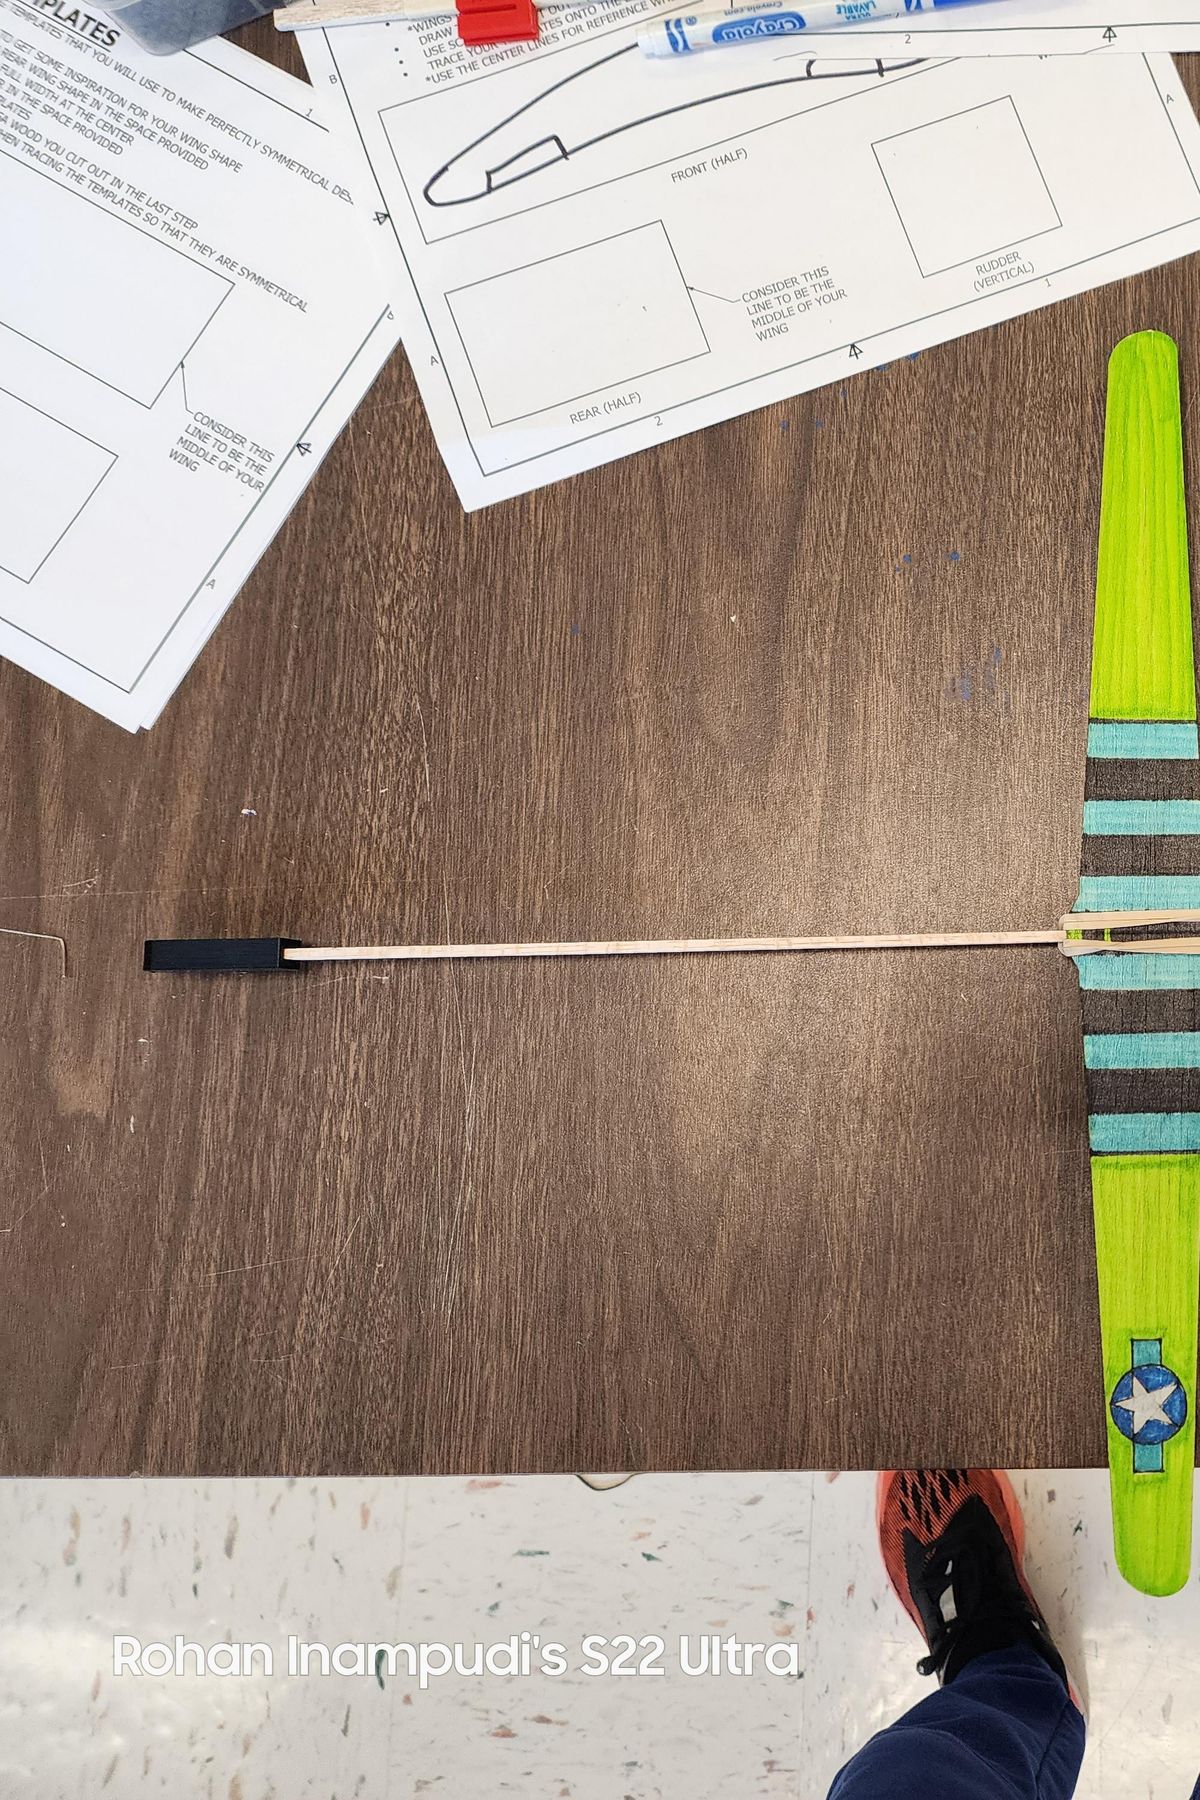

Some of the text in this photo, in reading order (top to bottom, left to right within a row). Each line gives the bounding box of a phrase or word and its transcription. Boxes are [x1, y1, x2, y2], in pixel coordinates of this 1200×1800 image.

[418, 27, 453, 46] DRAW
[427, 51, 465, 70] TRACE
[466, 42, 499, 58] YOUR
[565, 5, 597, 23] ONTO
[456, 61, 480, 76] THE
[482, 45, 526, 67] CENTER
[527, 33, 560, 51] LINES
[561, 24, 585, 39] FOR
[586, 1, 649, 30] REFERENCE
[721, 16, 800, 41] Crayola
[905, 34, 911, 44] 2
[423, 43, 447, 58] USE
[328, 74, 338, 84] B
[14, 39, 36, 54] GET
[34, 50, 65, 73] SOME
[63, 66, 127, 108] INSPIRATION
[127, 103, 149, 120] FOR
[150, 115, 178, 138] YOUR
[180, 131, 209, 154] WING
[208, 148, 243, 173] SHAPE
[25, 78, 59, 102] WIDTH
[59, 99, 76, 111] AT
[74, 105, 96, 123] THE
[95, 118, 134, 146] CENTER
[65, 33, 92, 53] THAT
[92, 49, 113, 67] YOU
[114, 61, 137, 81] WILL
[138, 76, 161, 93] USE
[161, 88, 177, 102] TO
[176, 97, 206, 119] MAKE
[205, 113, 261, 149] PERFECTLY
[260, 144, 329, 190] SYMMETRICAL
[1166, 94, 1174, 104] A
[5, 83, 19, 96] IN
[20, 91, 42, 109] THE
[40, 104, 73, 128] SPACE
[72, 122, 123, 155] PROVIDED
[28, 63, 58, 85] WING
[57, 80, 90, 103] SHAPE
[89, 98, 103, 111] IN
[104, 105, 125, 123] THE
[124, 117, 158, 142] SPACE
[157, 136, 209, 171] PROVIDED
[10, 119, 199, 230] WOOD YOU CUT OUT IN THE LAST STEP
[671, 148, 748, 183] FRONT (HALF)
[20, 141, 65, 172] TRACING
[66, 167, 87, 185] THE
[87, 179, 144, 217] TEMPLATES
[142, 212, 160, 226] SO
[160, 220, 189, 242] THAT
[188, 236, 217, 259] THEY
[215, 255, 239, 272] ARE
[237, 266, 308, 313] SYMMETRICAL
[973, 261, 1035, 293] (VERTICAL)
[975, 251, 1022, 276] RUDDER
[741, 266, 830, 303] CONSIDER THIS
[746, 279, 835, 316] LINE TO BE THE
[1045, 278, 1052, 288] 1
[751, 289, 848, 329] MIDDLE OF YOUR
[755, 322, 789, 342] WING
[431, 355, 439, 366] A
[569, 391, 641, 424] REAR (HALF)
[654, 415, 663, 426] 2
[184, 423, 268, 476] LINE TO BE THE
[193, 411, 275, 463] CONSIDER THIS
[168, 448, 200, 472] WING
[176, 436, 265, 493] MIDDLE OF YOUR
[206, 579, 216, 590] A
